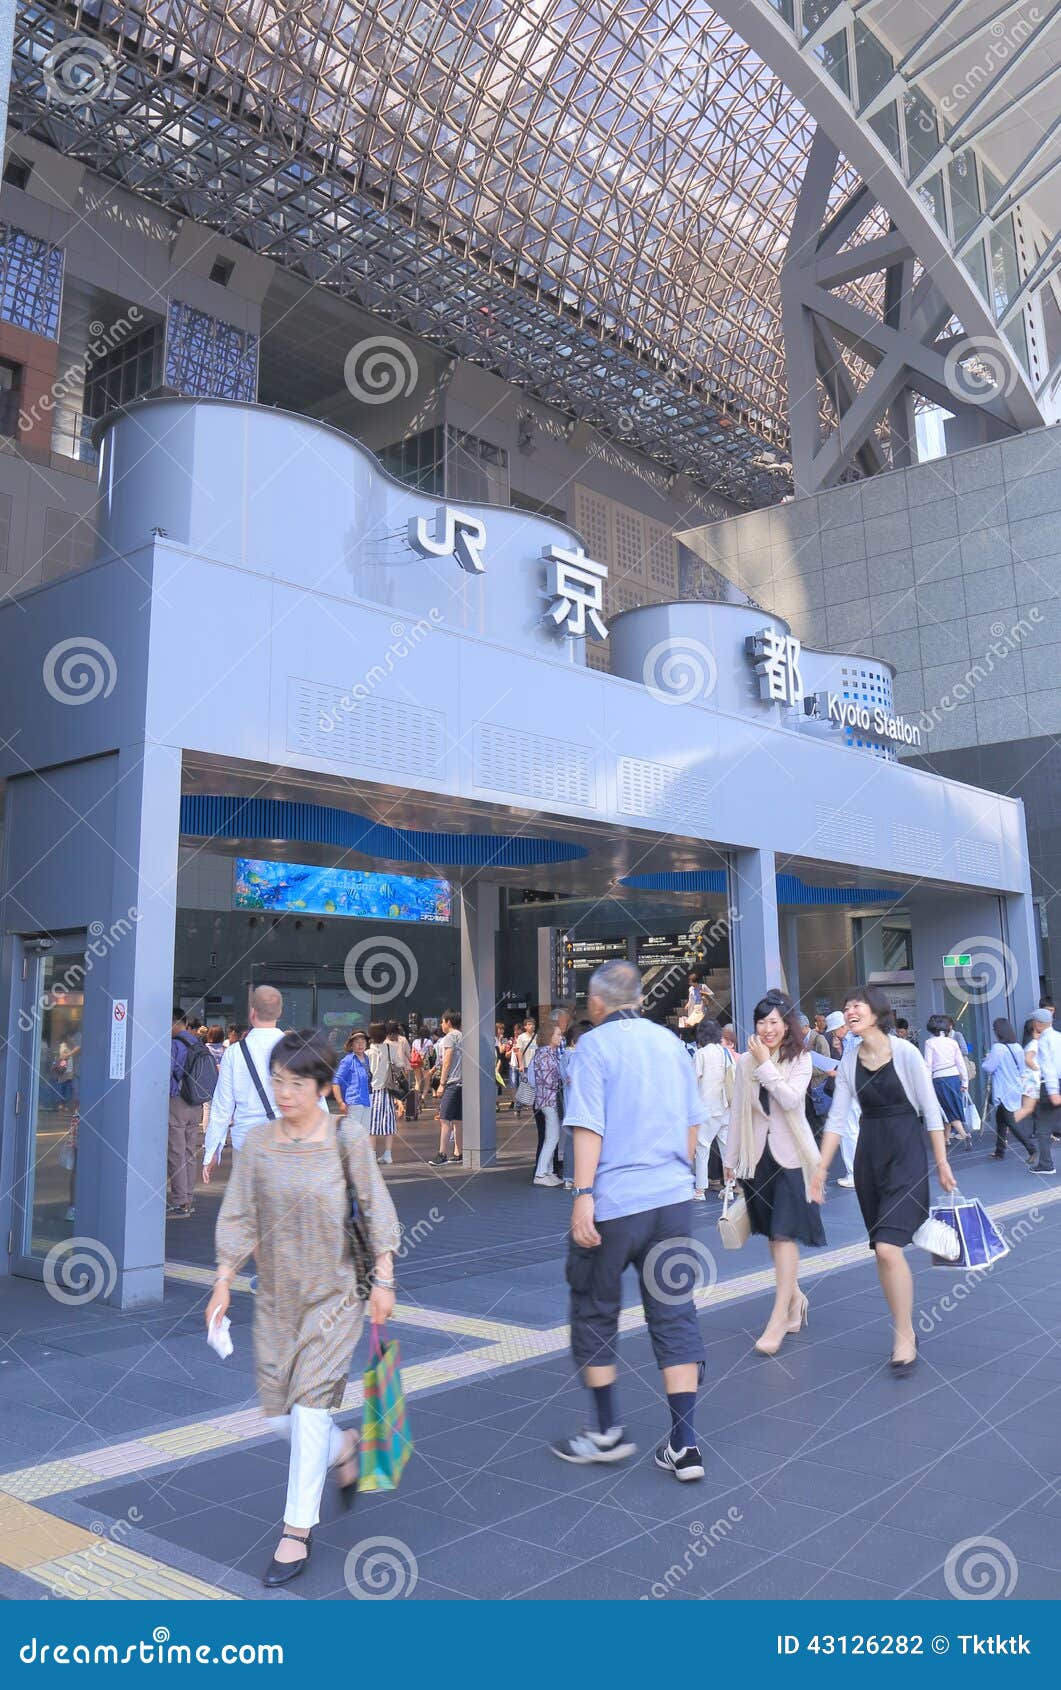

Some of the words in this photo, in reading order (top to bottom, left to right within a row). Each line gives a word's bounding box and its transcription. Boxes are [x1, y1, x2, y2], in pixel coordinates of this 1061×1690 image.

[408, 505, 487, 575] JR
[828, 692, 871, 730] Kyoto
[874, 706, 921, 746] Station
